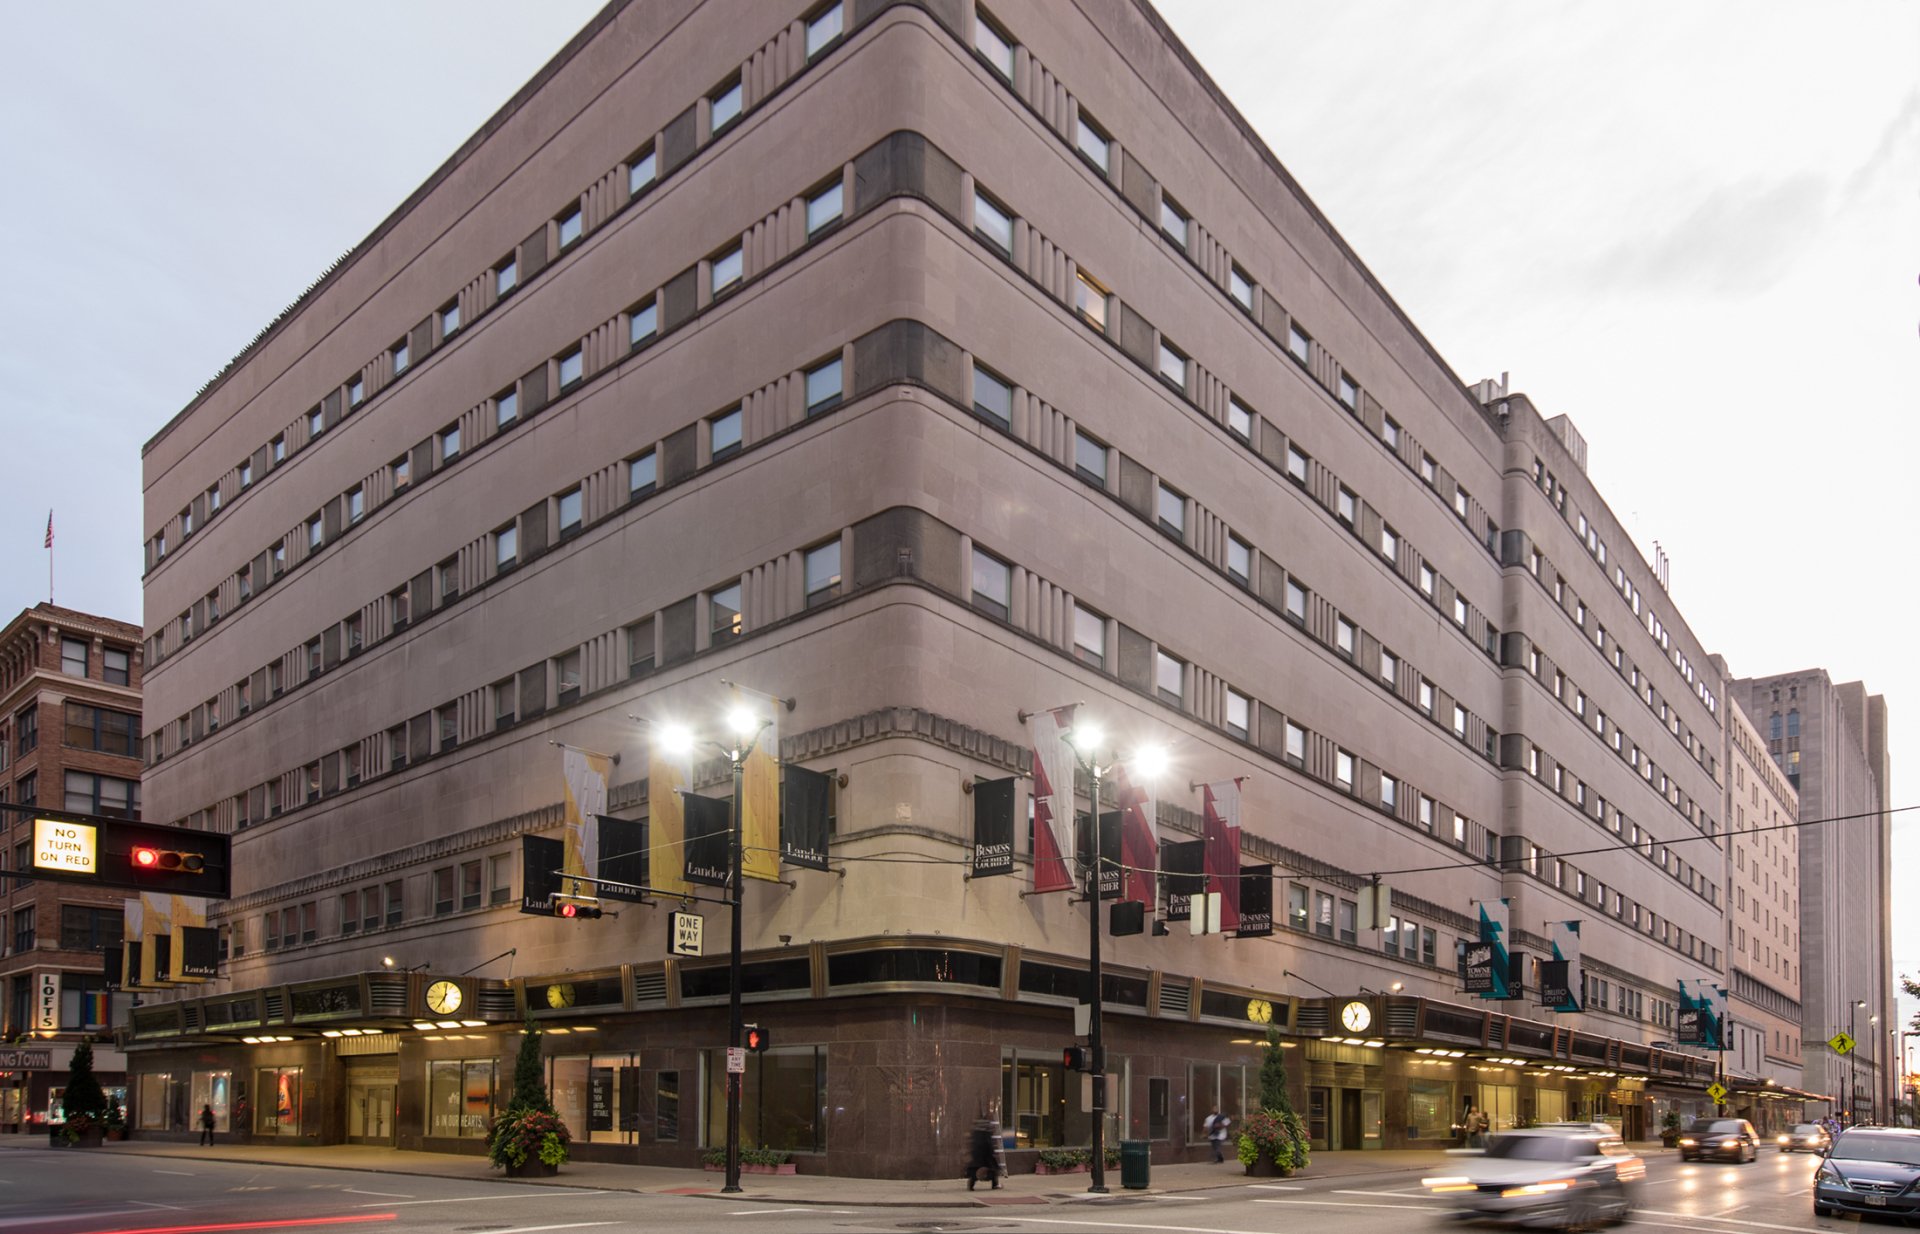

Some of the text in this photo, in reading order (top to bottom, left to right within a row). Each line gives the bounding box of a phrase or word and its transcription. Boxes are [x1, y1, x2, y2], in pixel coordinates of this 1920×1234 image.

[55, 828, 76, 839] NO
[48, 840, 82, 852] TURN
[976, 843, 1011, 857] BUSINESS
[40, 852, 90, 866] ON RED
[787, 842, 824, 864] Landor
[975, 855, 1010, 869] COURIER
[687, 861, 727, 881] Landor
[1086, 870, 1120, 882] BINESS
[1085, 881, 1119, 894] CRIER
[525, 896, 549, 909] Lan
[1170, 893, 1191, 905] BUSIN
[1169, 904, 1191, 914] COUR
[679, 916, 699, 930] ONE
[679, 928, 699, 942] WAY
[184, 964, 216, 975] Landor
[42, 975, 55, 1027] LOFTS
